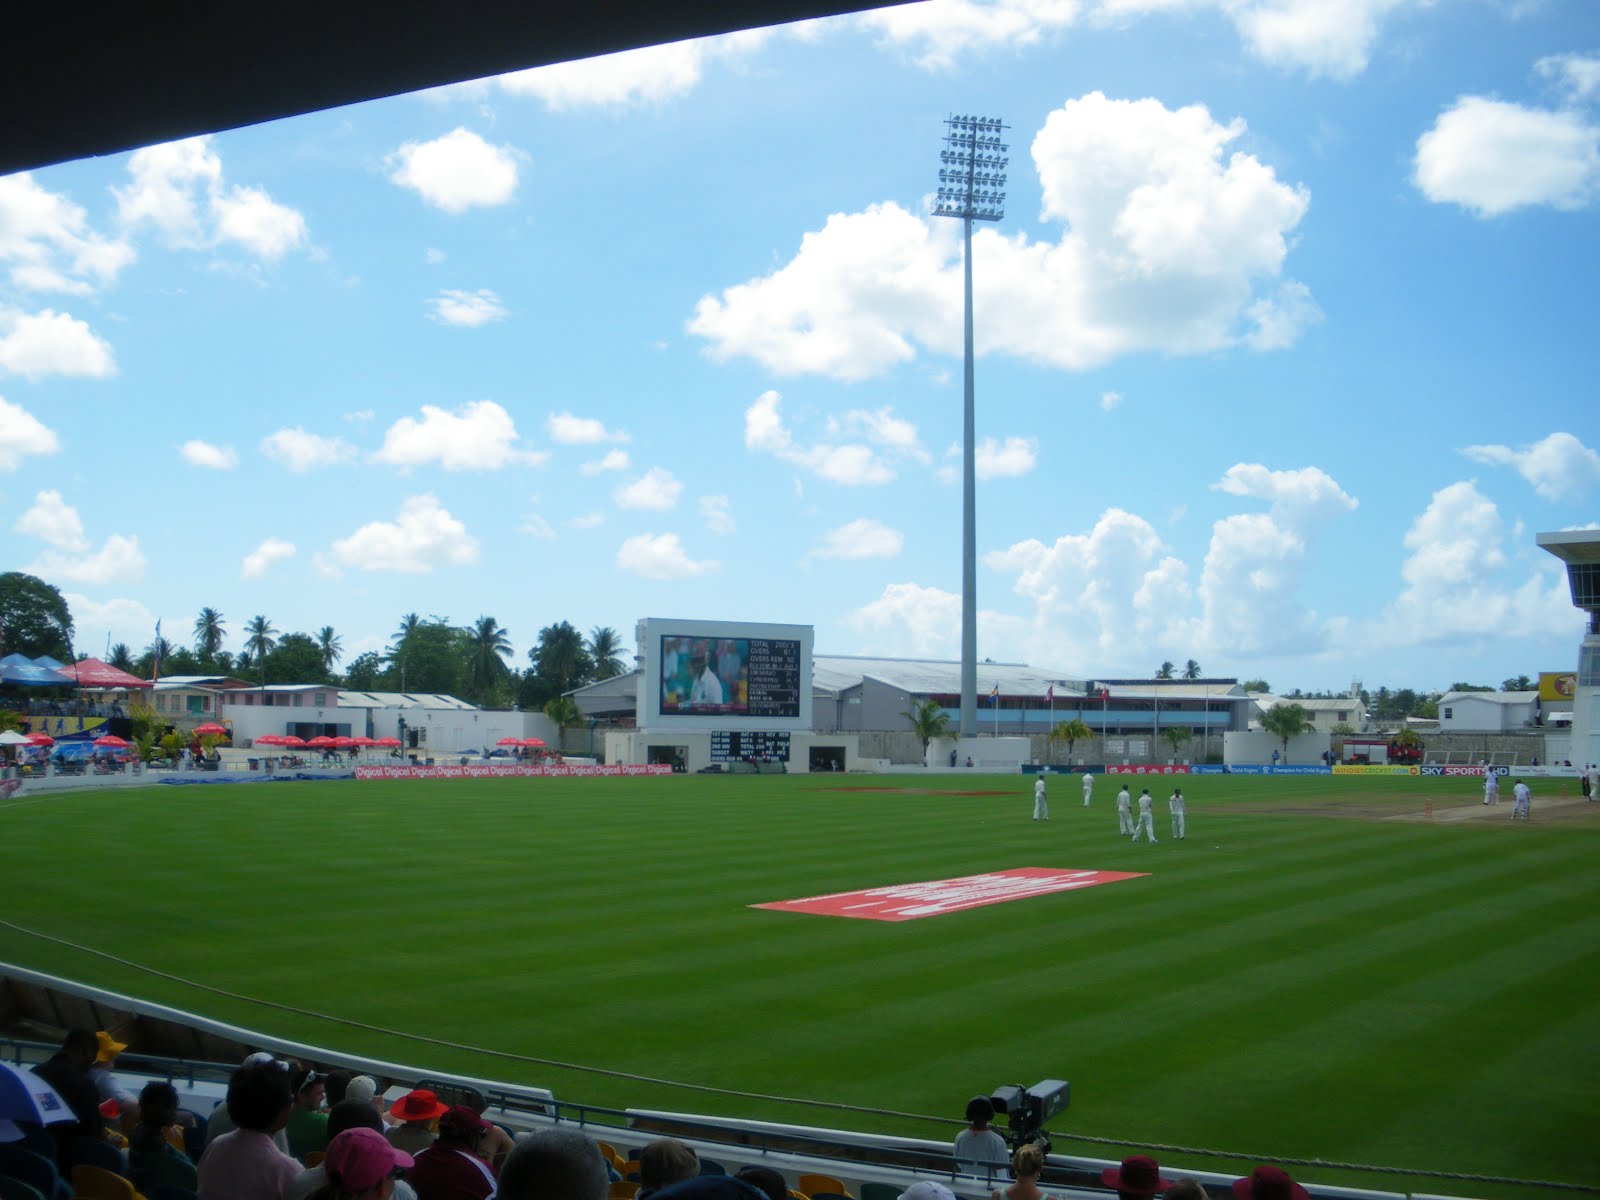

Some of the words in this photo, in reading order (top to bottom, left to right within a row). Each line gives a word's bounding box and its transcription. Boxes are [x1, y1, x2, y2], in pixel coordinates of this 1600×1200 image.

[356, 767, 382, 778] Digicel
[384, 767, 410, 778] Digicel
[411, 767, 435, 778] Digicel
[437, 767, 462, 778] Digicel
[464, 767, 488, 777] Digicel
[491, 766, 515, 776] Digicel
[518, 766, 542, 776] Digicel
[544, 766, 568, 776] Digicel
[570, 766, 593, 776] Digicel
[596, 766, 620, 776] Digicel
[622, 766, 646, 776] Digicel
[648, 765, 672, 776] Digicel
[1422, 767, 1443, 776] SKY
[1446, 768, 1484, 776] SPORTS
[1493, 768, 1508, 776] HD
